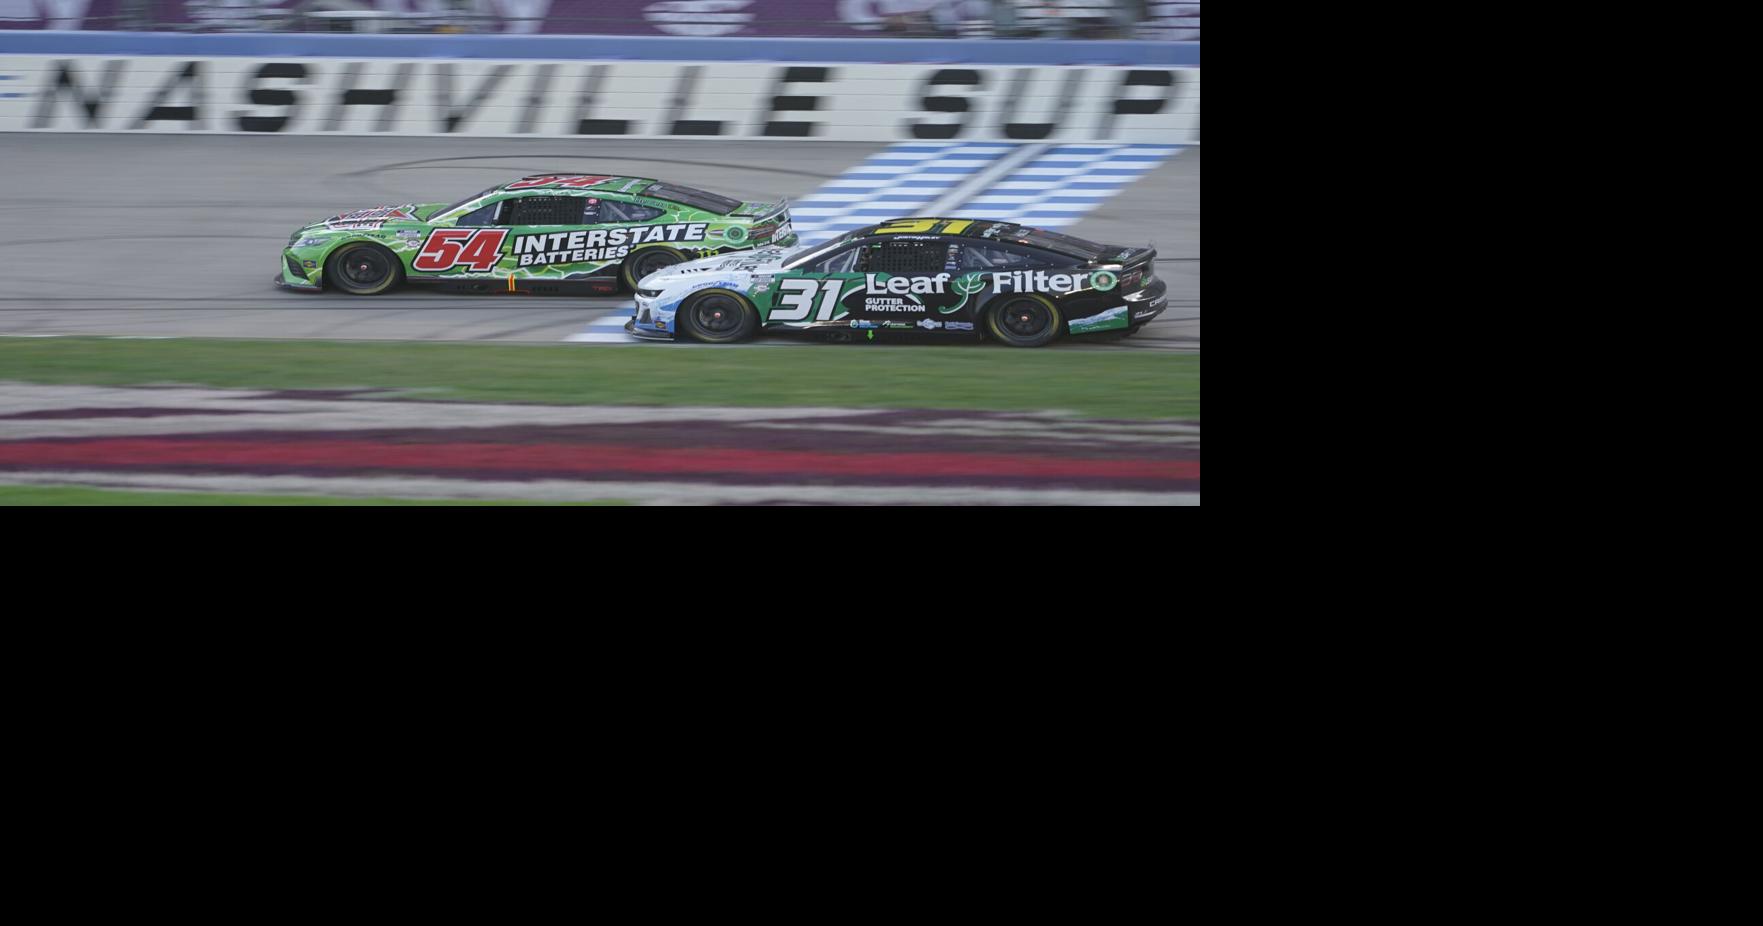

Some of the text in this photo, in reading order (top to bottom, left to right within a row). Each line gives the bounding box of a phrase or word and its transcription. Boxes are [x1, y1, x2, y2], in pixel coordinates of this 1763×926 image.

[24, 59, 838, 138] NASHVILLE
[514, 223, 707, 254] INTERSTATE
[875, 219, 972, 235] 31
[413, 228, 511, 271] 54
[519, 245, 630, 266] BATTERIES
[865, 270, 1088, 295] Leaf Filter
[769, 279, 843, 321] 31
[865, 297, 904, 305] GUTTER
[865, 304, 926, 312] PROTECTION
